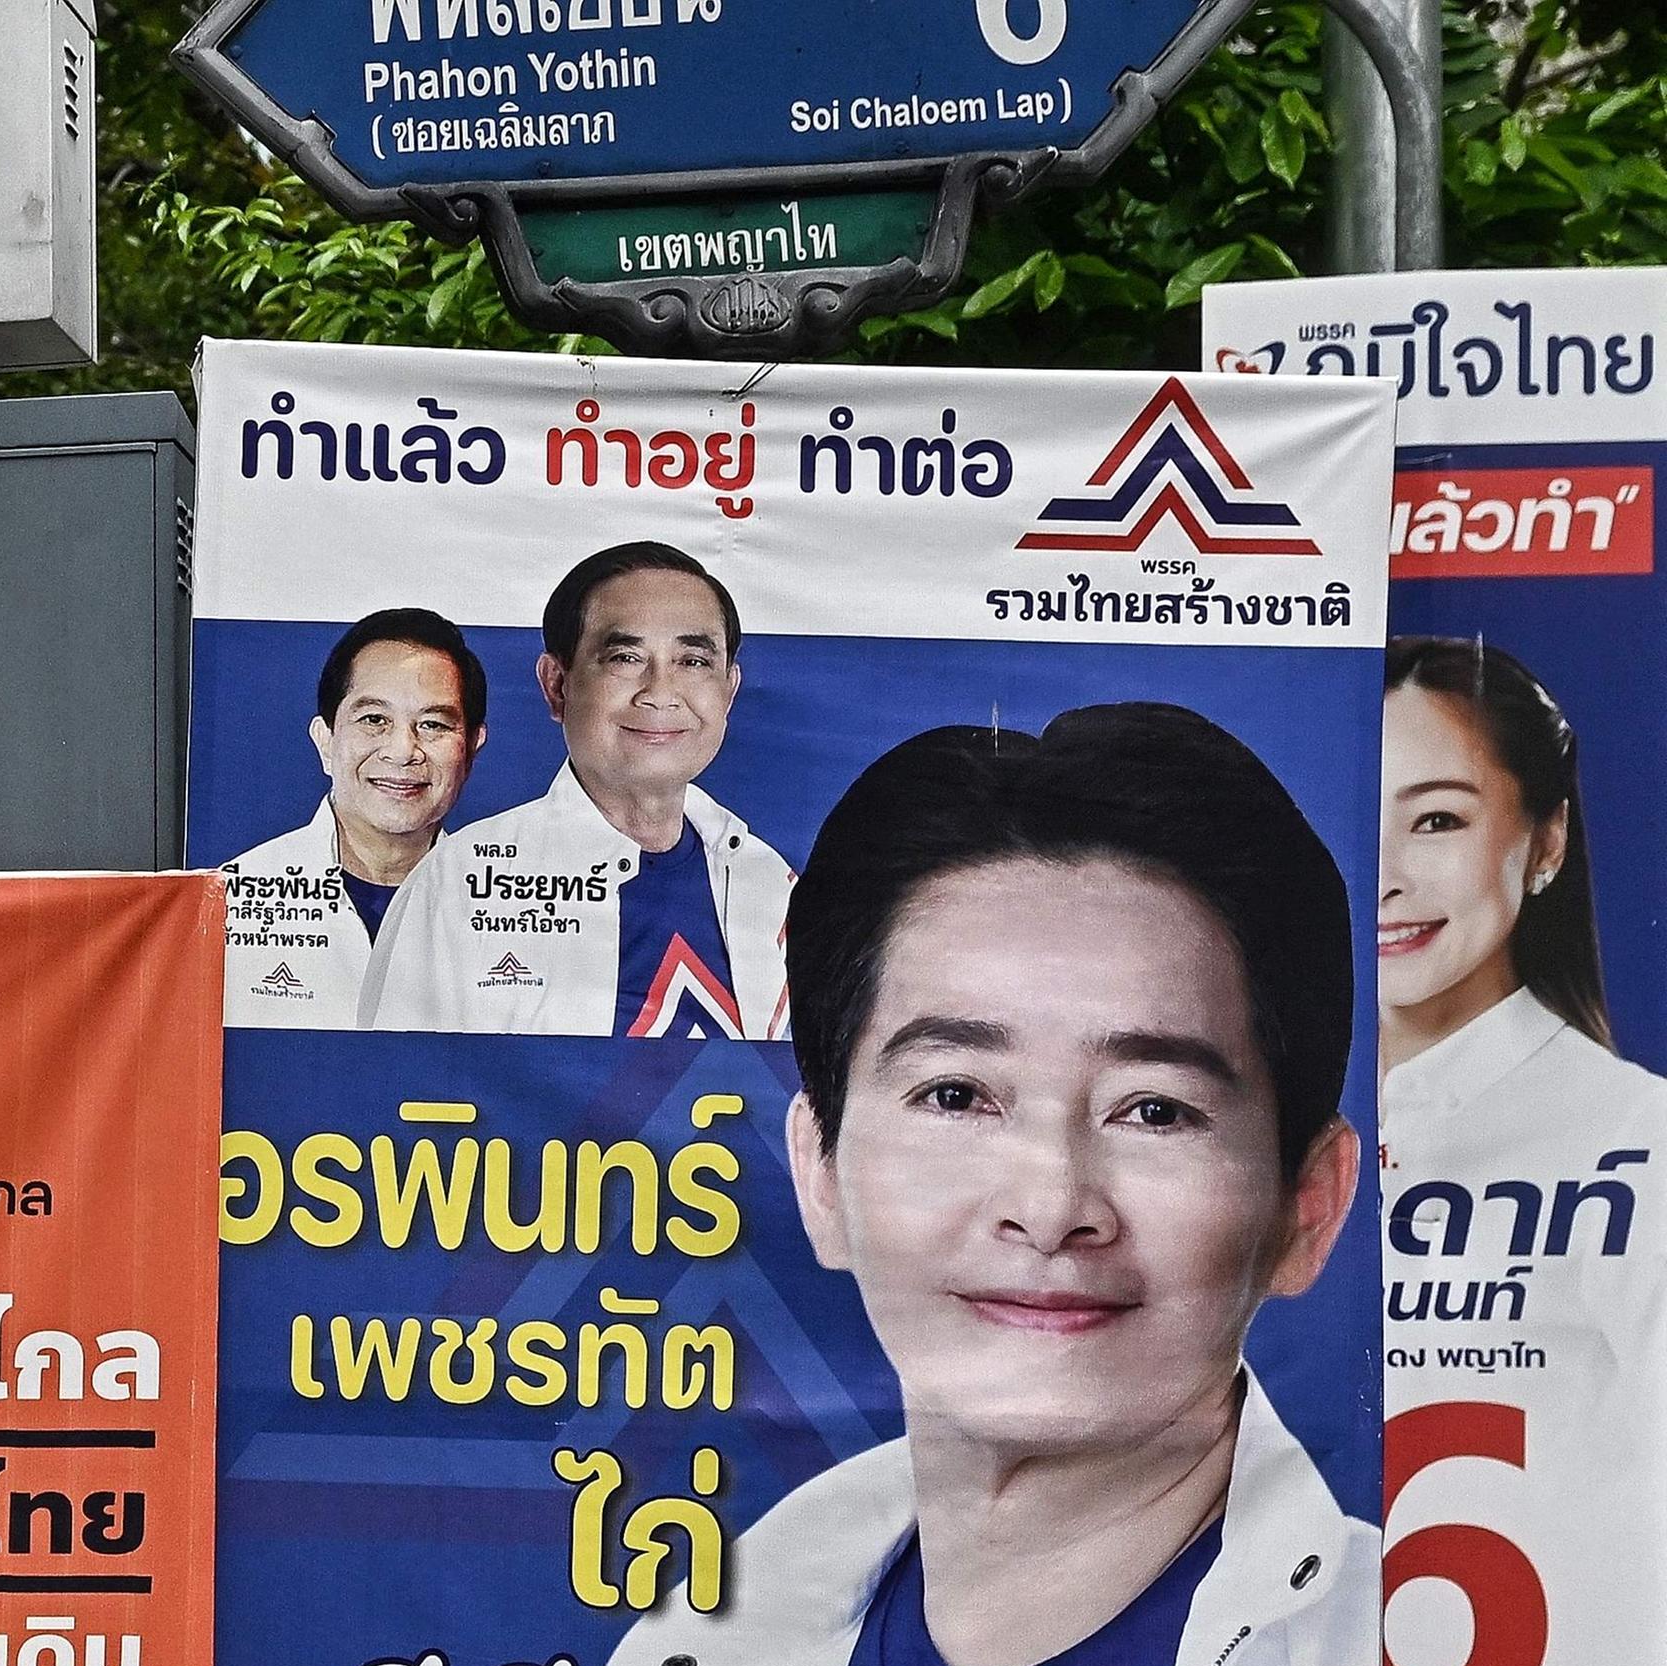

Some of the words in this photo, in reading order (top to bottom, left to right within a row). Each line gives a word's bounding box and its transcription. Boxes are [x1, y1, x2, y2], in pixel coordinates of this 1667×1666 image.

[364, 58, 516, 102] Phahon
[527, 47, 657, 92] Yothin
[790, 98, 841, 133] Soi
[850, 91, 987, 130] Chaloem
[617, 201, 838, 272] เขตพญาไท
[1299, 323, 1356, 342] พรรค
[240, 392, 506, 485] ทำแล้ว
[544, 400, 757, 518] ทำอยู่
[798, 408, 1013, 498] ทำต่อ
[1140, 557, 1197, 577] พรรค
[986, 574, 1353, 628] รวมไทยสร้างชาติ
[466, 862, 609, 917] ประยุทธ์
[470, 909, 581, 934] จันทร์โอชา
[219, 1094, 744, 1257] อรพินทร์
[290, 1287, 735, 1412] เพชรทัต
[1438, 1341, 1546, 1373] พญาไท
[553, 1447, 722, 1612] ไก่
